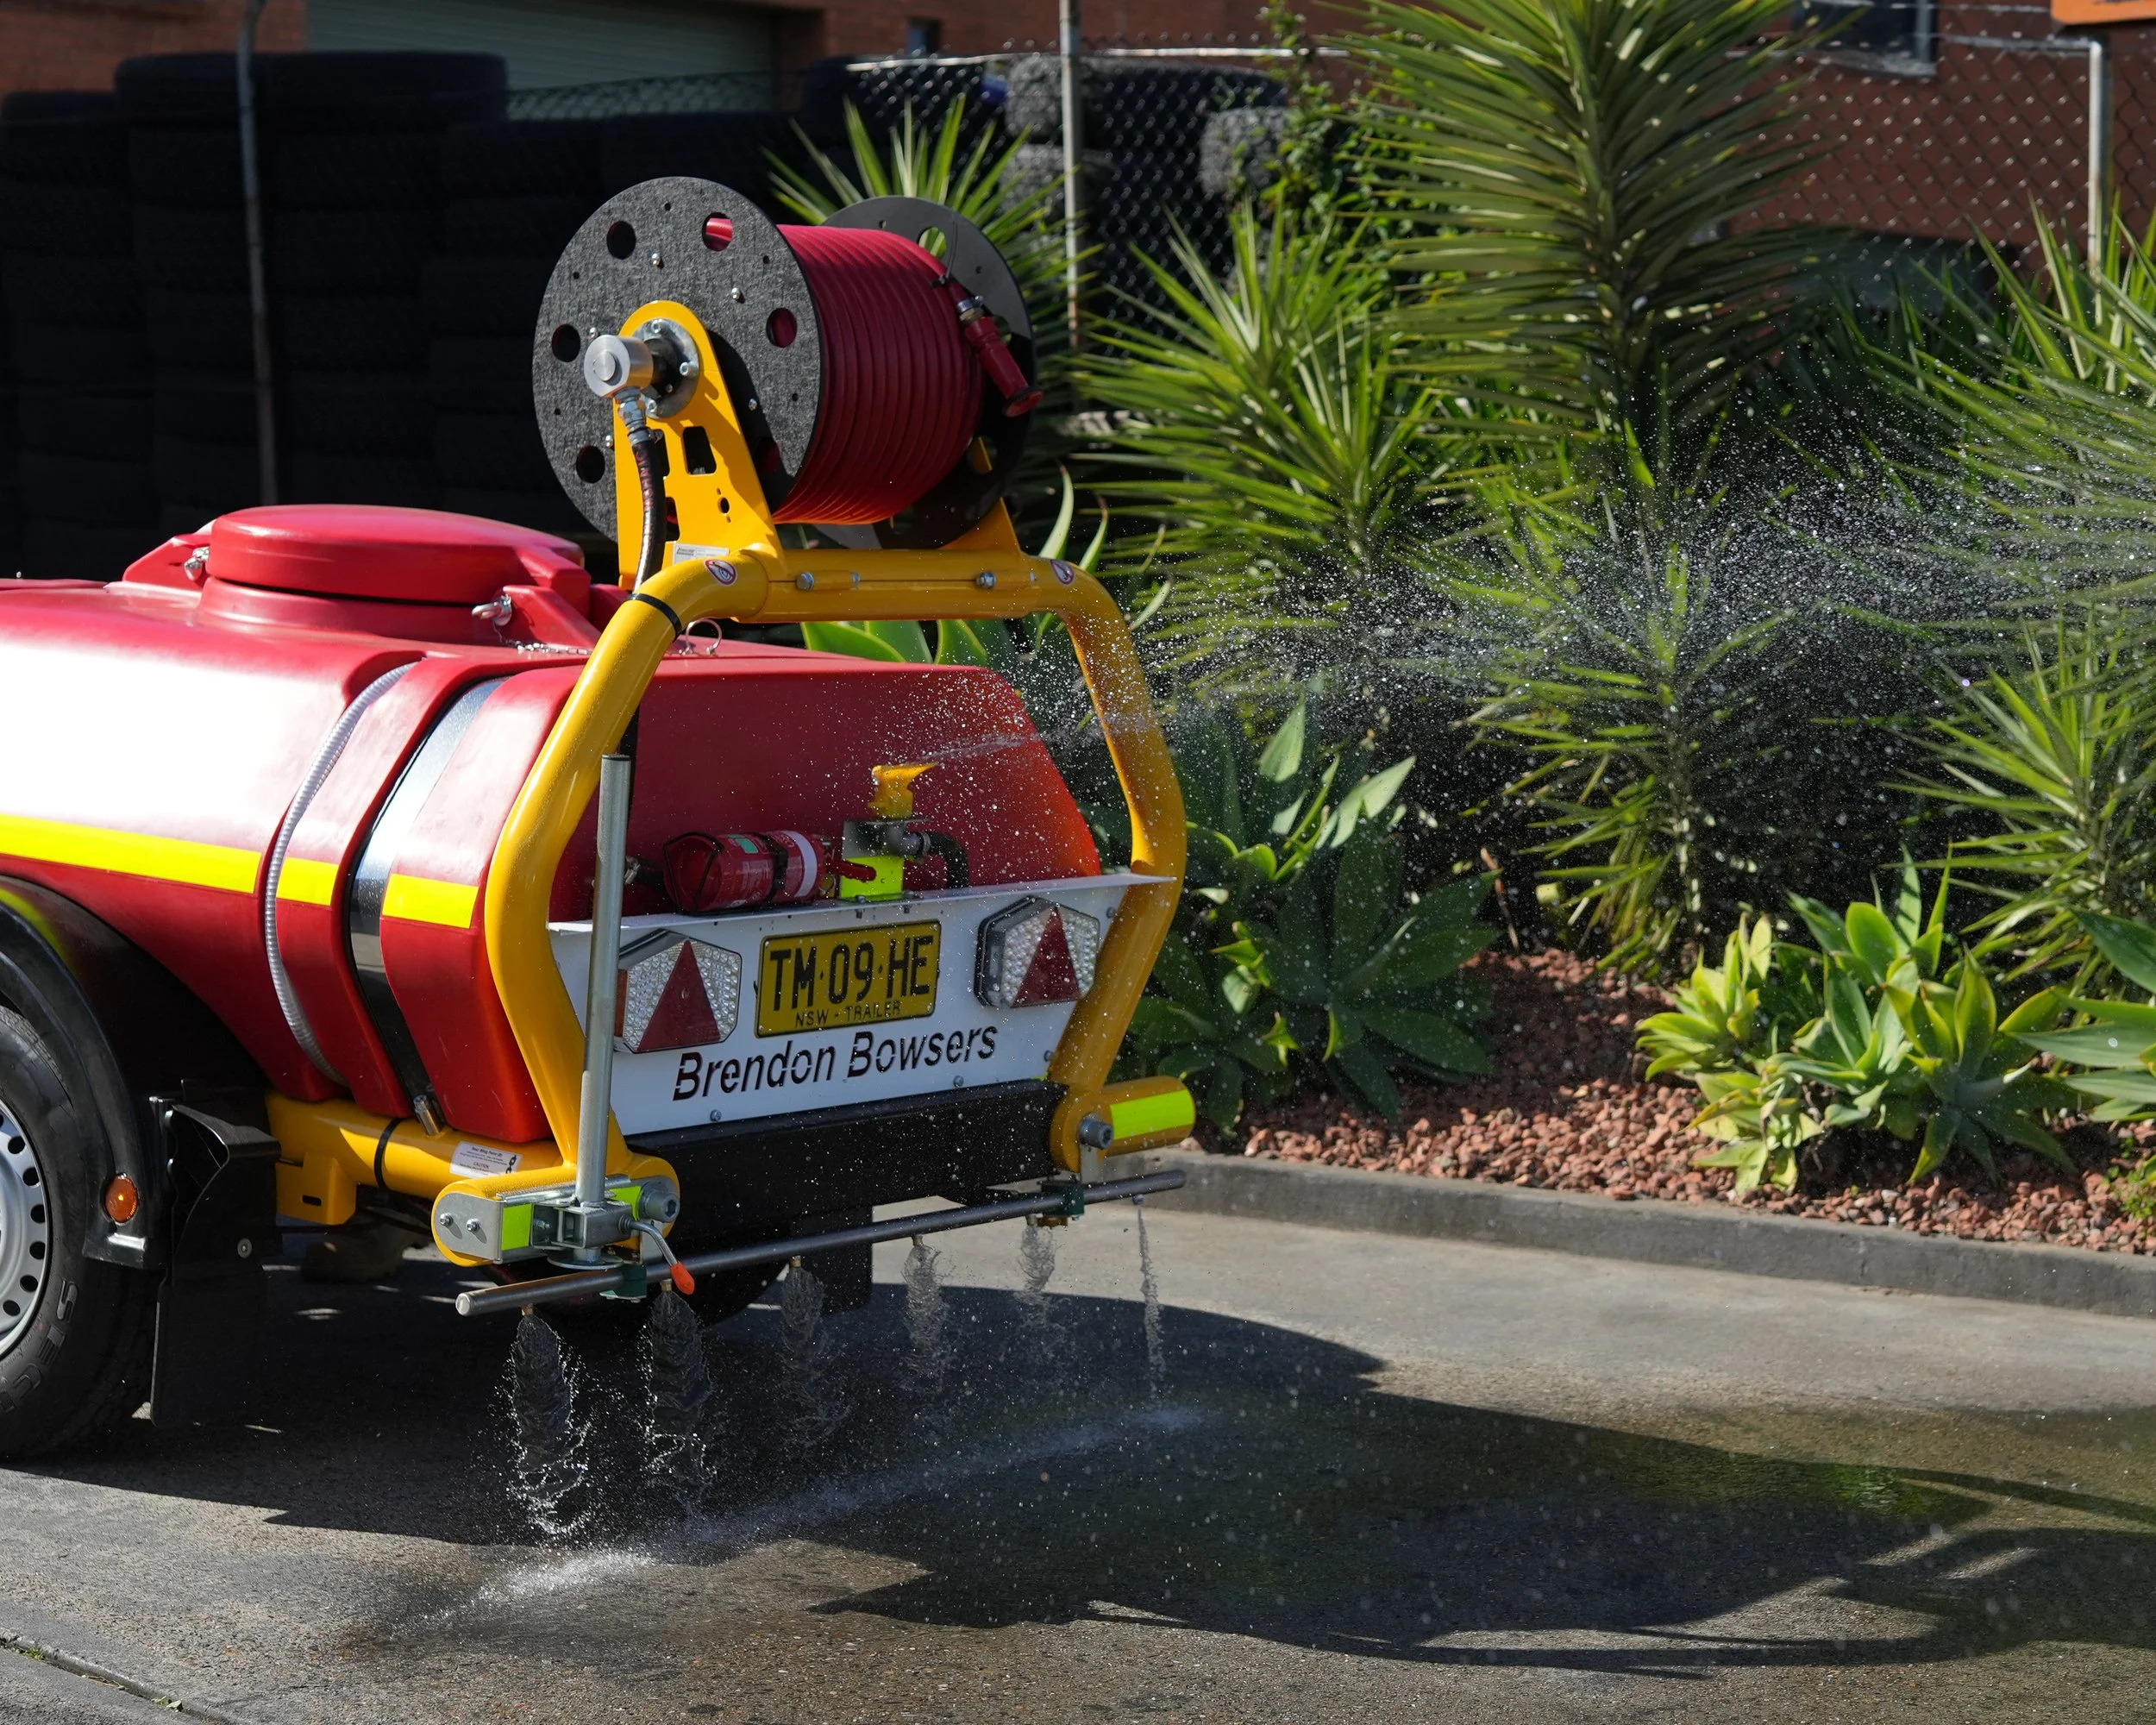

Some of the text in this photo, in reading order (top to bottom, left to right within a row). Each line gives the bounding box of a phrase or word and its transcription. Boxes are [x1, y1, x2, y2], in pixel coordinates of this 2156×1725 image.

[795, 1008, 830, 1028] NSW
[845, 1000, 900, 1023] TRAILER
[673, 1026, 998, 1101] Brendon Bowsers
